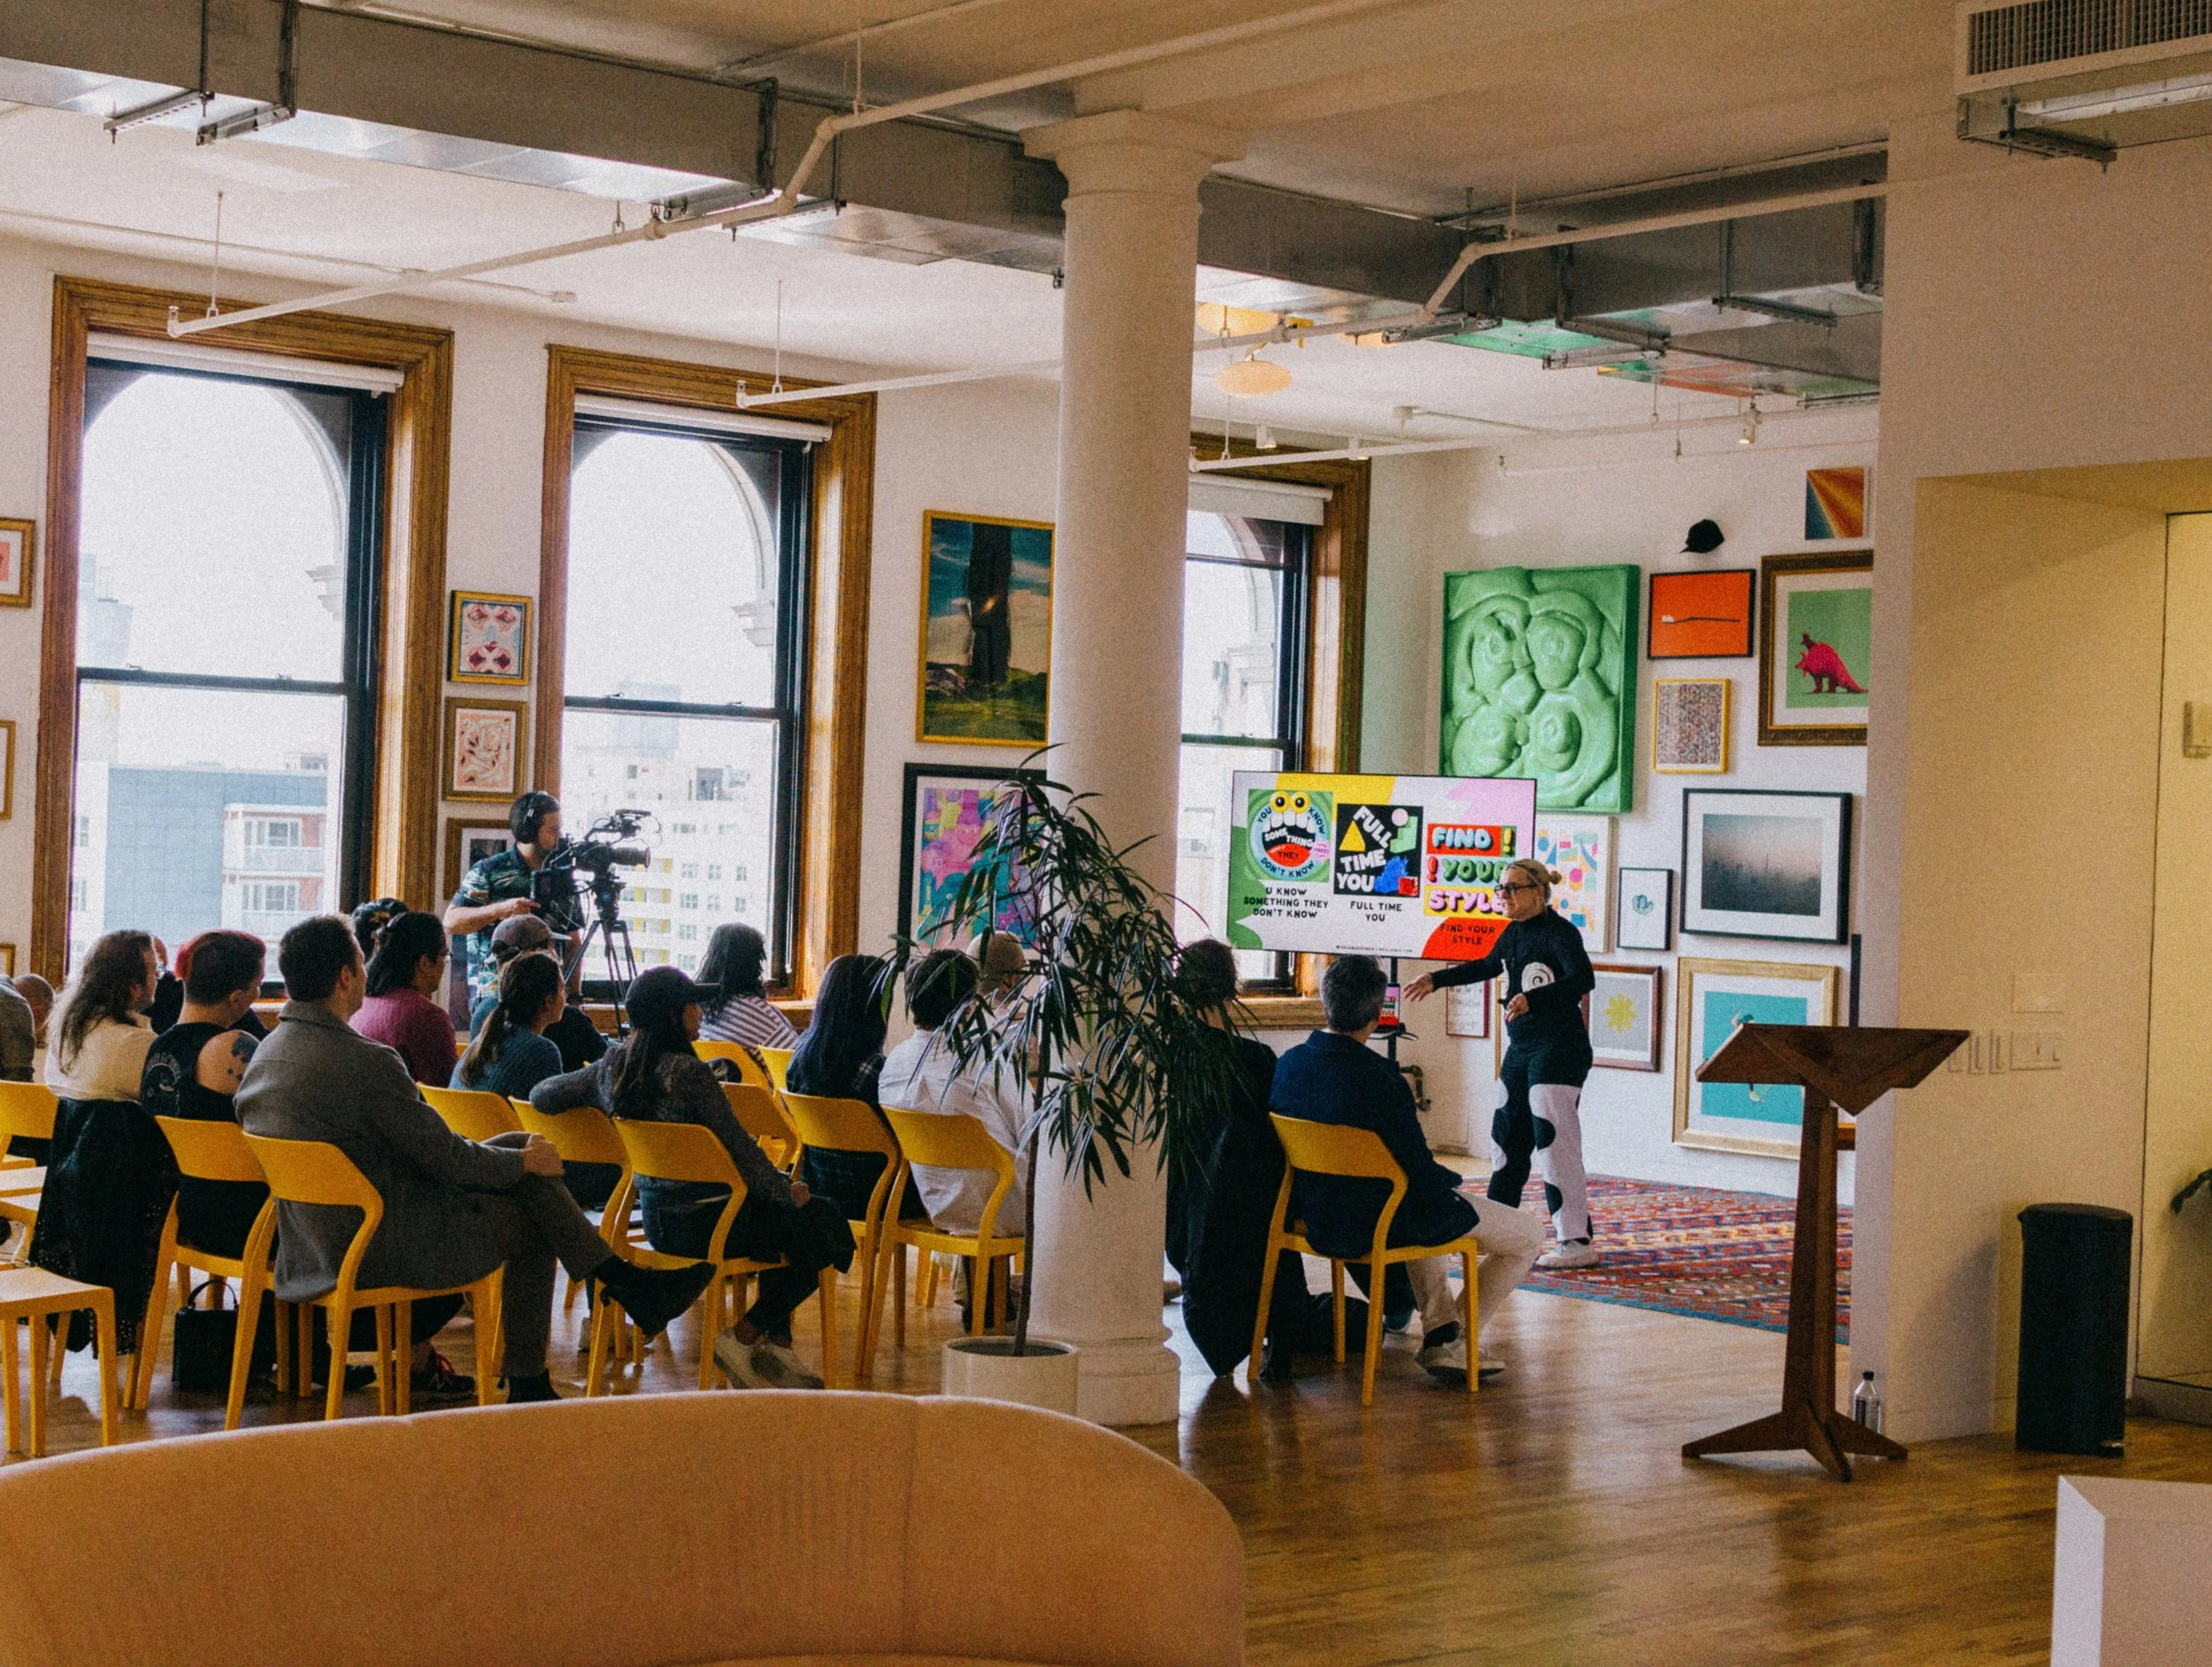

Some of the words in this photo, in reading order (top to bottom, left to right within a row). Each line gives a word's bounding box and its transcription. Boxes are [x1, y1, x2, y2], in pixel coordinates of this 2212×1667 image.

[1256, 806, 1272, 823] YOU
[1307, 807, 1325, 834] KNOW
[1352, 805, 1392, 849] FULL
[1264, 827, 1288, 841] SOME
[1432, 826, 1493, 849] FIND
[1502, 827, 1514, 854] !
[1286, 835, 1314, 848] THING
[1260, 857, 1286, 876] DON'T
[1288, 861, 1314, 878] KNOW
[1340, 849, 1386, 872] TIME
[1336, 872, 1375, 893] YOU
[1276, 887, 1307, 896] KNOW
[1243, 896, 1300, 907] SOMETHING
[1303, 899, 1329, 909] THEY
[1350, 901, 1373, 910] FULL
[1379, 903, 1402, 911] TIME
[1428, 888, 1504, 915] STYLE
[1253, 908, 1283, 918] DON'T
[1286, 909, 1317, 918] KNOW
[1440, 923, 1463, 933] FIND
[1467, 925, 1495, 933] YOUR
[1452, 934, 1483, 945] STYLE
